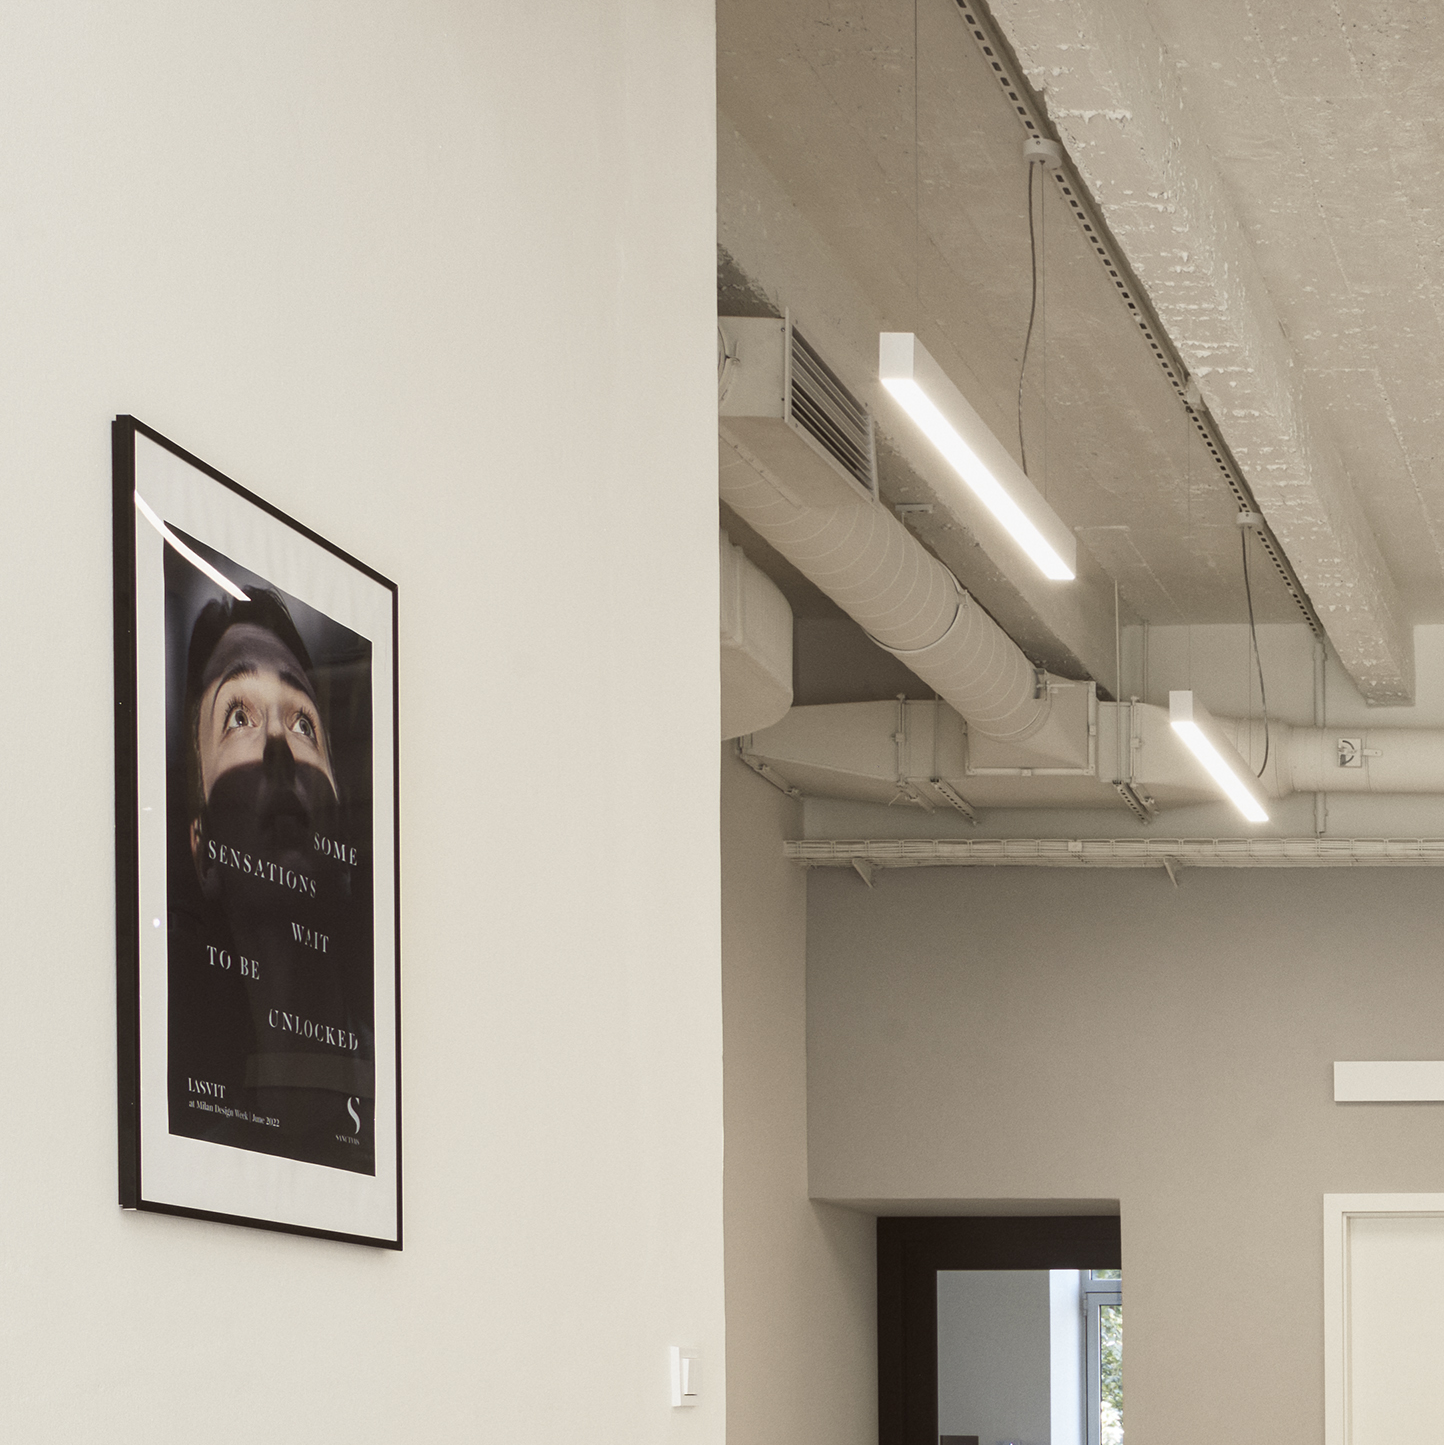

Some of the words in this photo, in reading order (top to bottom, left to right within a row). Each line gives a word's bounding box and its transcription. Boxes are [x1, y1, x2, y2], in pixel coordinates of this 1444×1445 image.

[313, 832, 358, 866] SOME
[208, 839, 317, 899] SENSATIONS
[291, 922, 329, 953] WAIT
[206, 945, 232, 970] TO
[240, 956, 260, 980] BE
[268, 1008, 359, 1051] UNLOCKED
[188, 1077, 226, 1099] LASVIT
[188, 1100, 195, 1108] at
[196, 1100, 214, 1112] Milan
[214, 1104, 234, 1118] Design
[234, 1108, 249, 1121] Week
[252, 1113, 265, 1125] June
[265, 1116, 280, 1128] 2022
